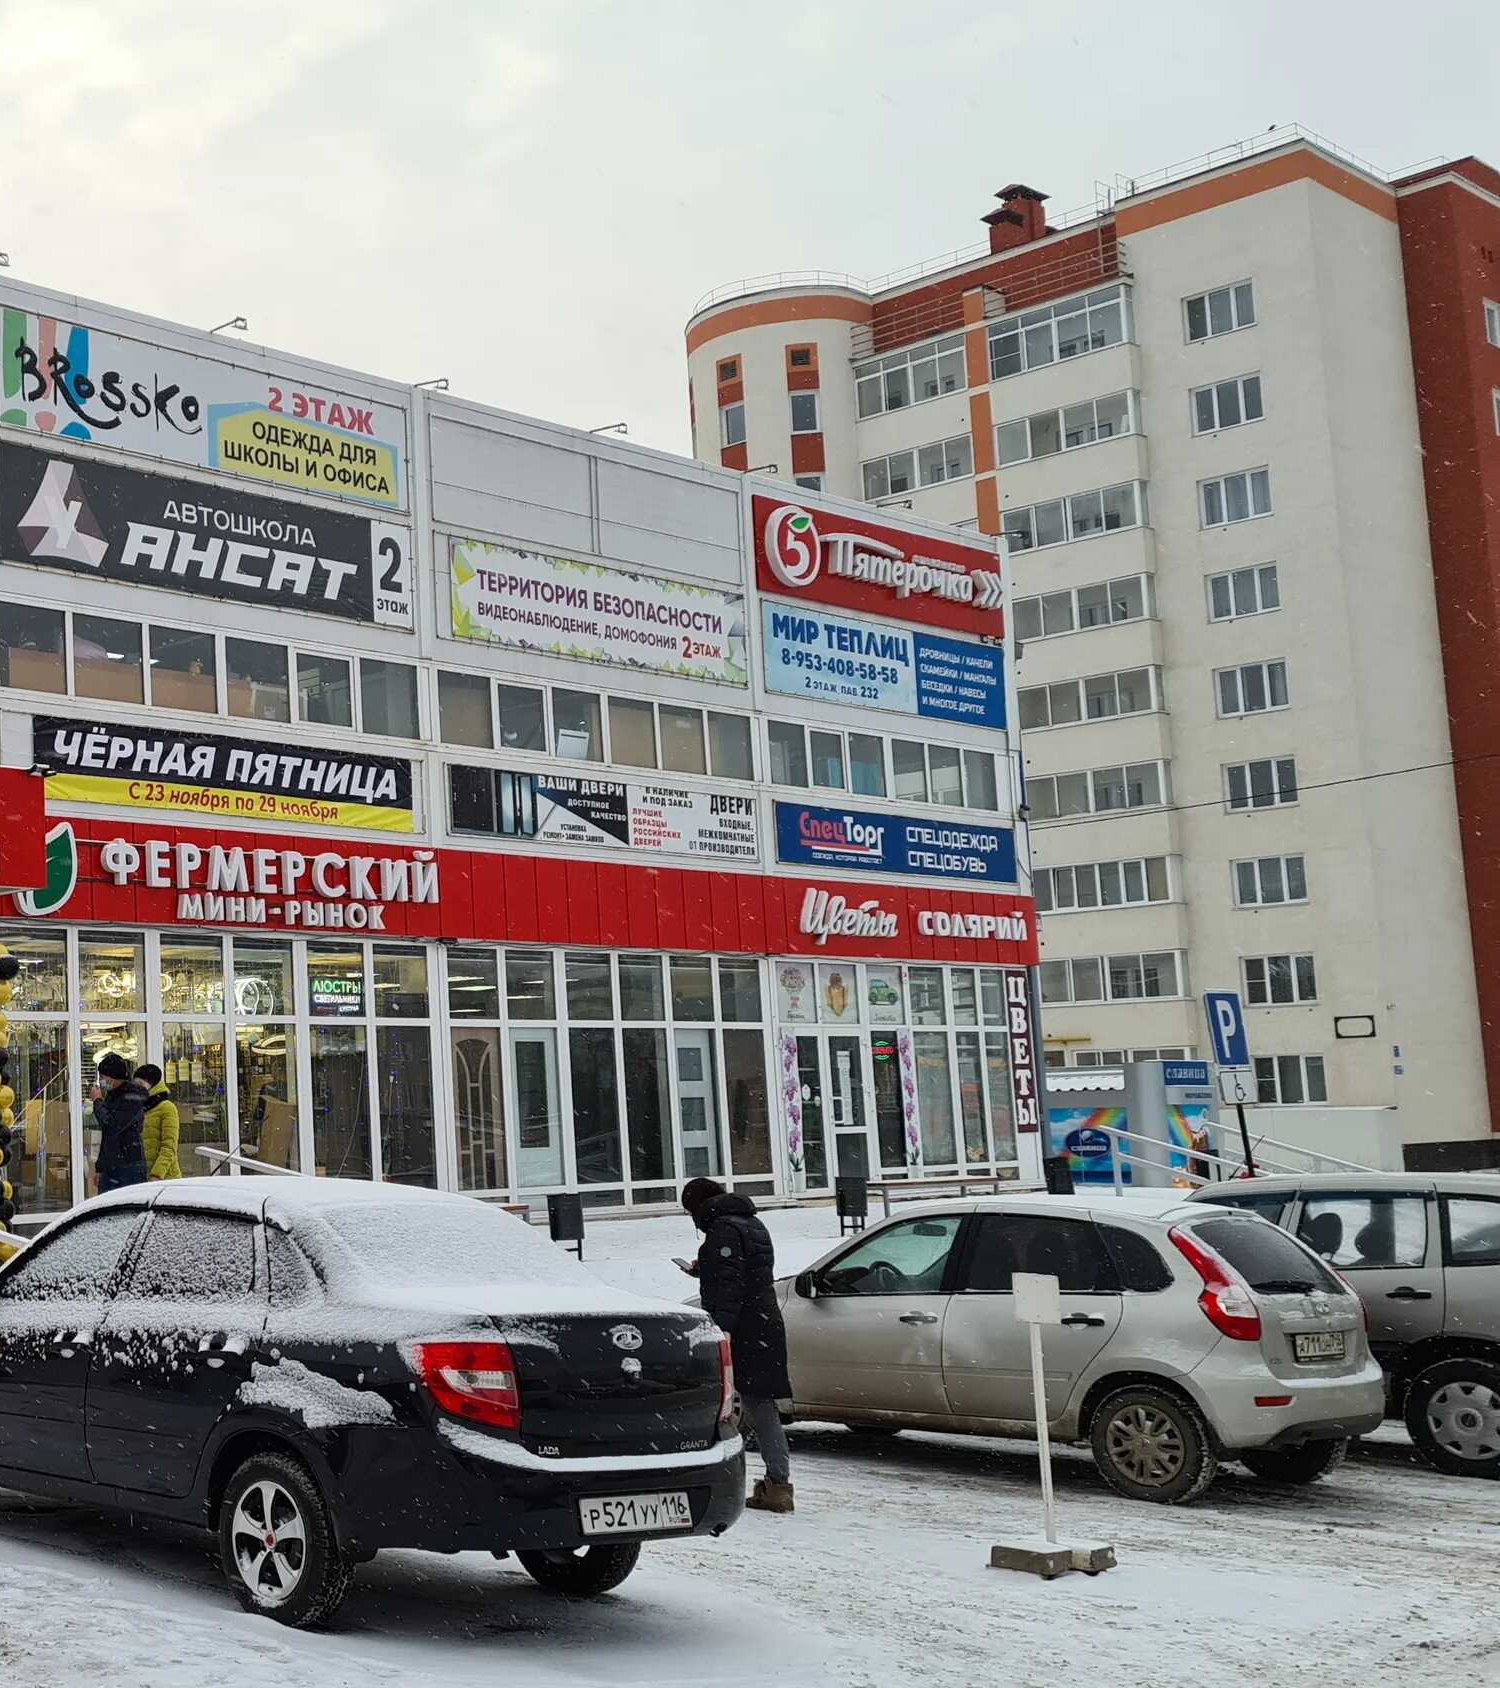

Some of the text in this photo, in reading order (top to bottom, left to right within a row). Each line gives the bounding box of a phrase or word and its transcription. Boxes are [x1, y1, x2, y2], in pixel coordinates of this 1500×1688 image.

[268, 387, 375, 435] 2 ЭТАЖ
[252, 421, 377, 466] ОДЕЖДА ДЛЯ
[224, 439, 389, 494] ШКОЛЫ И ОФИСА
[163, 499, 316, 548] АВТОШКОЛА
[120, 521, 358, 600] АНСАТ
[378, 536, 403, 595] 2
[376, 598, 409, 615] этаж
[476, 569, 723, 635] ТЕРРИТОРИЯ БЕЗОПАСНОСТИ
[477, 601, 677, 651] ВИДЕОНАБЛЮДЕНИЕ, ДОМОФОНИЯ
[772, 612, 910, 667] МИР ТЕПЛИЦ
[781, 647, 898, 684] 8-953-408-58-58
[920, 648, 960, 664] ДРОВНИЦЫ
[966, 656, 993, 670] КАЧЕЛИ
[920, 663, 958, 679] СКАМЕЙКИ
[964, 671, 997, 686] МАНГАЛЫ
[805, 676, 812, 689] 2
[861, 687, 879, 699] 232
[921, 680, 953, 693] БЕСЕДКИ
[959, 686, 986, 699] НАВЕСЫ
[929, 696, 958, 710] МНОГОЕ
[959, 702, 985, 714] ДРУГОЕ
[54, 727, 398, 804] ЧЁРНАЯ ПЯТНИЦА
[537, 775, 624, 797] ВАШИ ДВЕРИ
[129, 782, 339, 820] С 23 ноября по 29 ноября
[567, 798, 610, 809] ДОСТУПНОЕ
[632, 808, 663, 817] ЛУЧШИЕ
[649, 797, 667, 807] ПОД
[668, 799, 693, 808] ЗАКАЗ
[710, 794, 753, 816] ДВЕРИ
[591, 811, 626, 821] КАЧЕСТВО
[633, 817, 667, 828] ОБРАЗЦЫ
[719, 818, 754, 832] ВХОДНЫЕ,
[634, 838, 662, 847] ДВЕРЕЙ
[800, 811, 885, 850] СпецТорг
[906, 826, 998, 852] СПЕЦОДЕЖДА
[688, 841, 756, 856] ОТ ПРОИЗВОДИТЕЛЯ
[100, 838, 440, 904] ФЕРМЕРСКИЙ
[908, 850, 987, 873] СПЕЦОБУВЬ
[177, 892, 386, 930] МИНИ-РЫНОК
[801, 887, 899, 946] Цветы
[918, 911, 1028, 941] СОЛЯРИЙ
[1215, 999, 1237, 1059] P
[1007, 975, 1038, 1126] ЦВЕТЫ
[538, 1445, 560, 1455] LADA
[680, 1440, 708, 1450] GRANTA
[662, 1495, 685, 1515] 116
